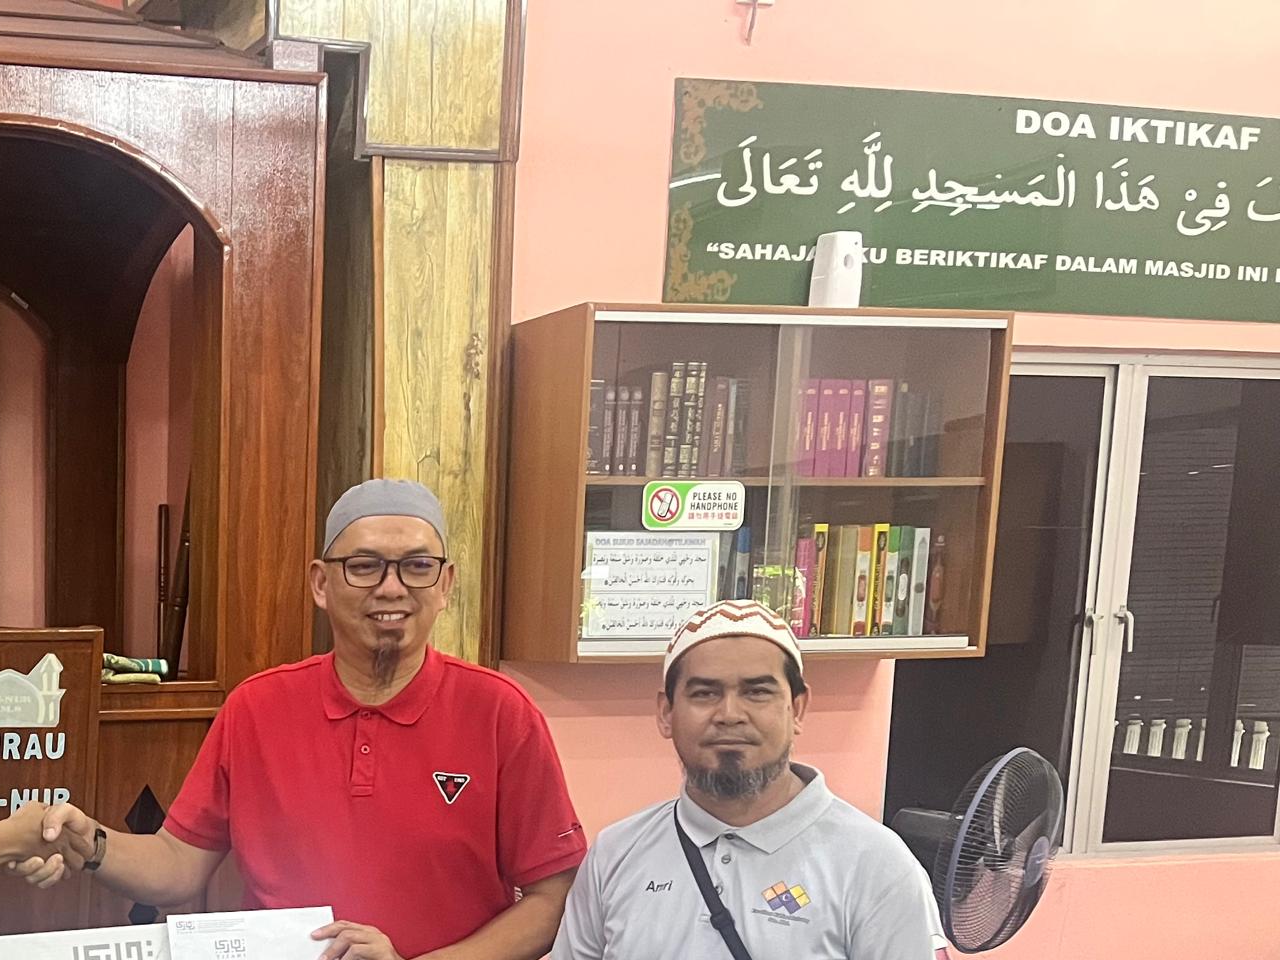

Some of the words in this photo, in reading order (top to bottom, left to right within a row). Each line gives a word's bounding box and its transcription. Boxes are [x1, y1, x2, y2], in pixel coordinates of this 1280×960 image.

[1016, 108, 1096, 139] DOA
[1109, 116, 1261, 151] IKTIKAF
[895, 248, 1049, 271] BERIKTIKAF
[1055, 254, 1137, 275] DALAM
[1144, 260, 1231, 281] MASJID
[1237, 265, 1268, 283] INI
[690, 502, 738, 511] HANDPHONE
[693, 492, 722, 501] PLEASE
[726, 492, 737, 501] NO
